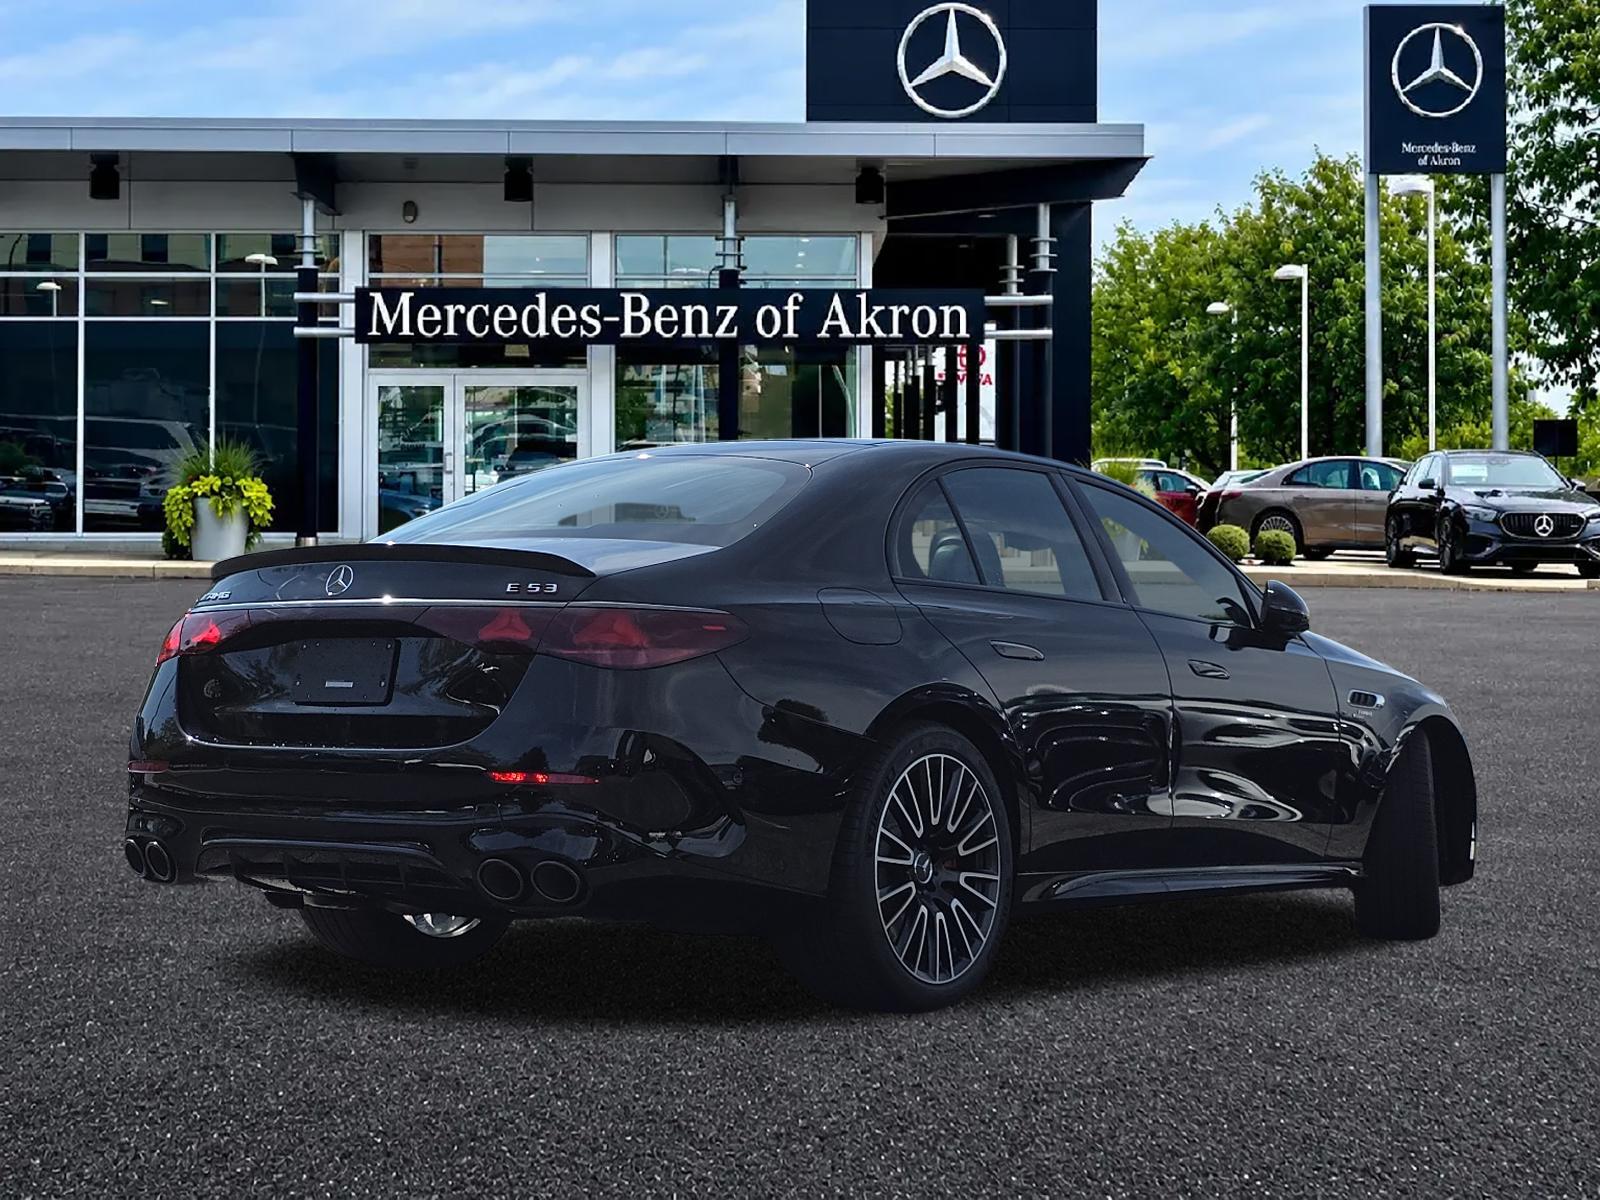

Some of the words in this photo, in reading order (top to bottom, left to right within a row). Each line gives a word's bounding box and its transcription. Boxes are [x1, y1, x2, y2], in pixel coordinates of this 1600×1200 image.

[1401, 142, 1476, 153] Mercedes-Benz
[1417, 154, 1428, 166] of
[1430, 155, 1461, 166] Akron
[367, 291, 738, 338] Mercedes-Benz
[755, 291, 803, 338] of
[816, 291, 971, 338] Akron
[506, 583, 520, 592] E
[527, 583, 558, 593] 53
